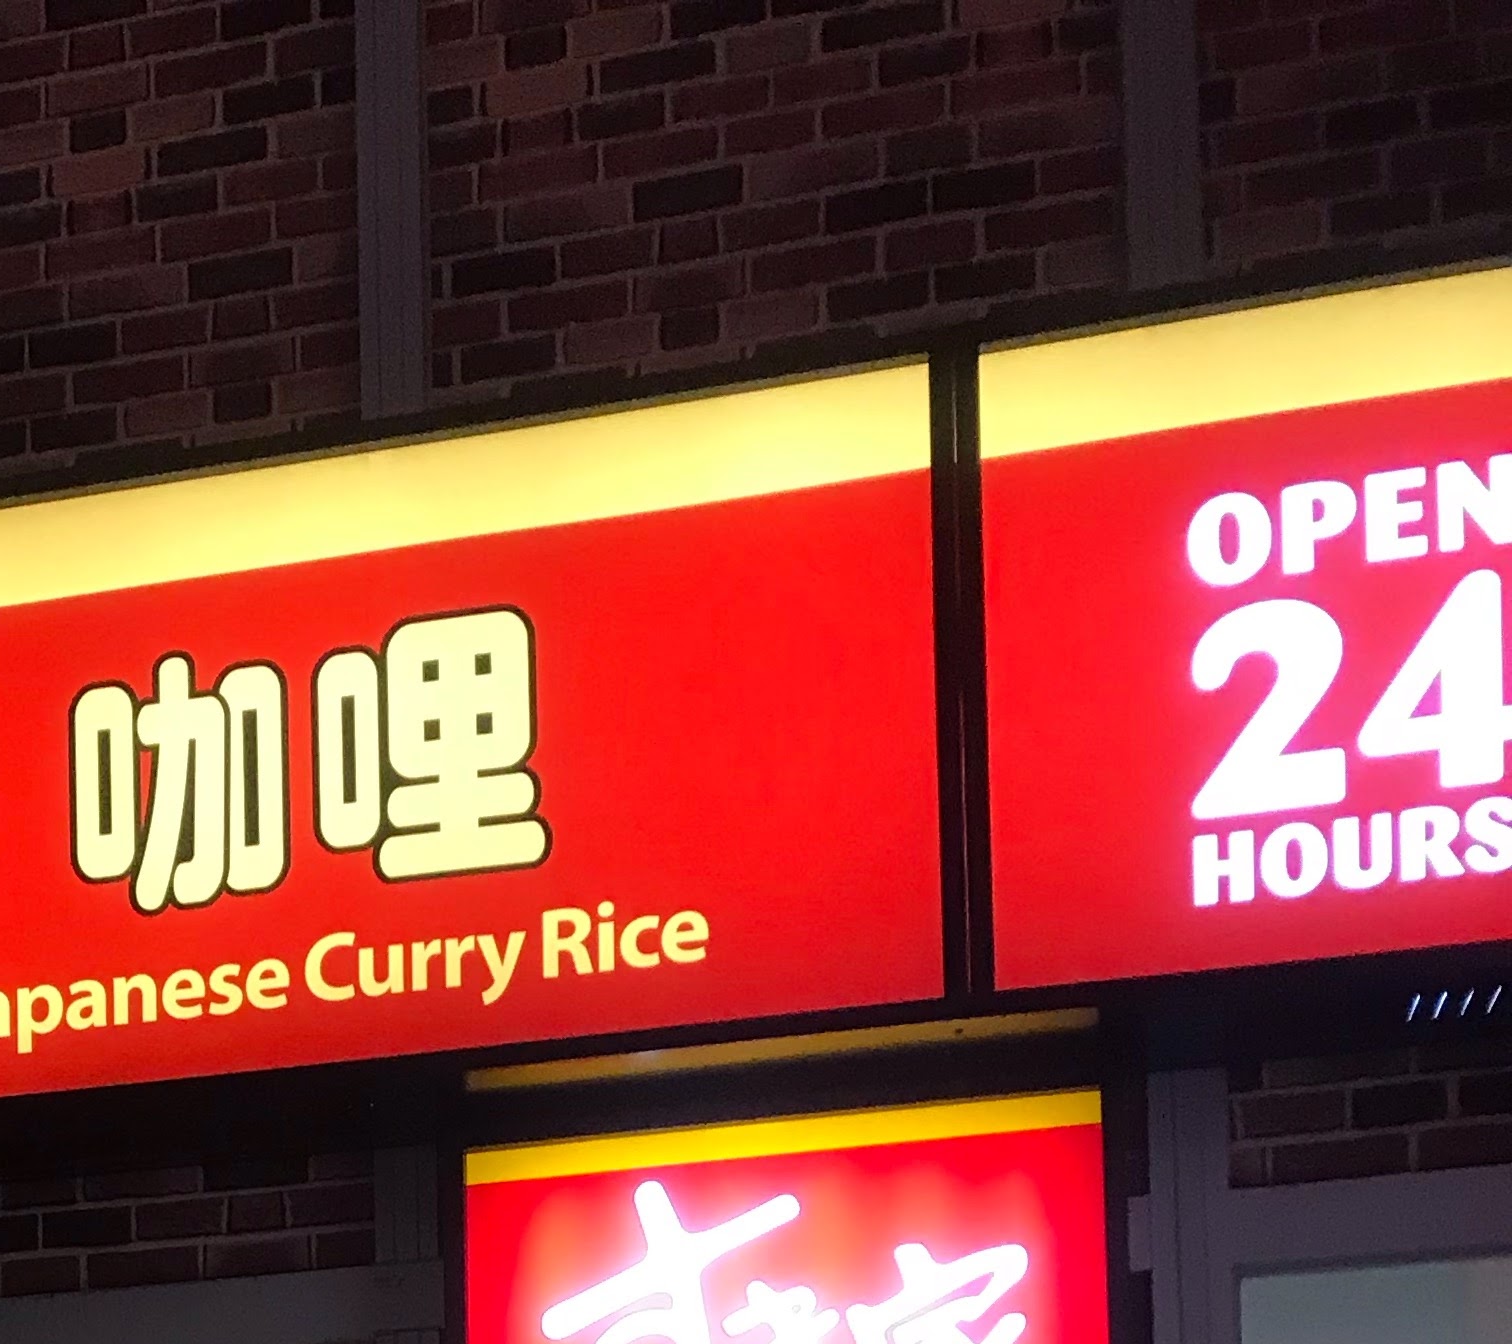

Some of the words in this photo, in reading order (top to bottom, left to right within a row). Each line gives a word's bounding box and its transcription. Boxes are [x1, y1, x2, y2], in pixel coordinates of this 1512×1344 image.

[1187, 453, 1512, 587] OPEN
[69, 604, 552, 916] 咖哩
[1191, 568, 1512, 820] 24
[1192, 795, 1512, 907] HOURS
[304, 928, 527, 1004] Curry
[542, 901, 709, 978] Rice
